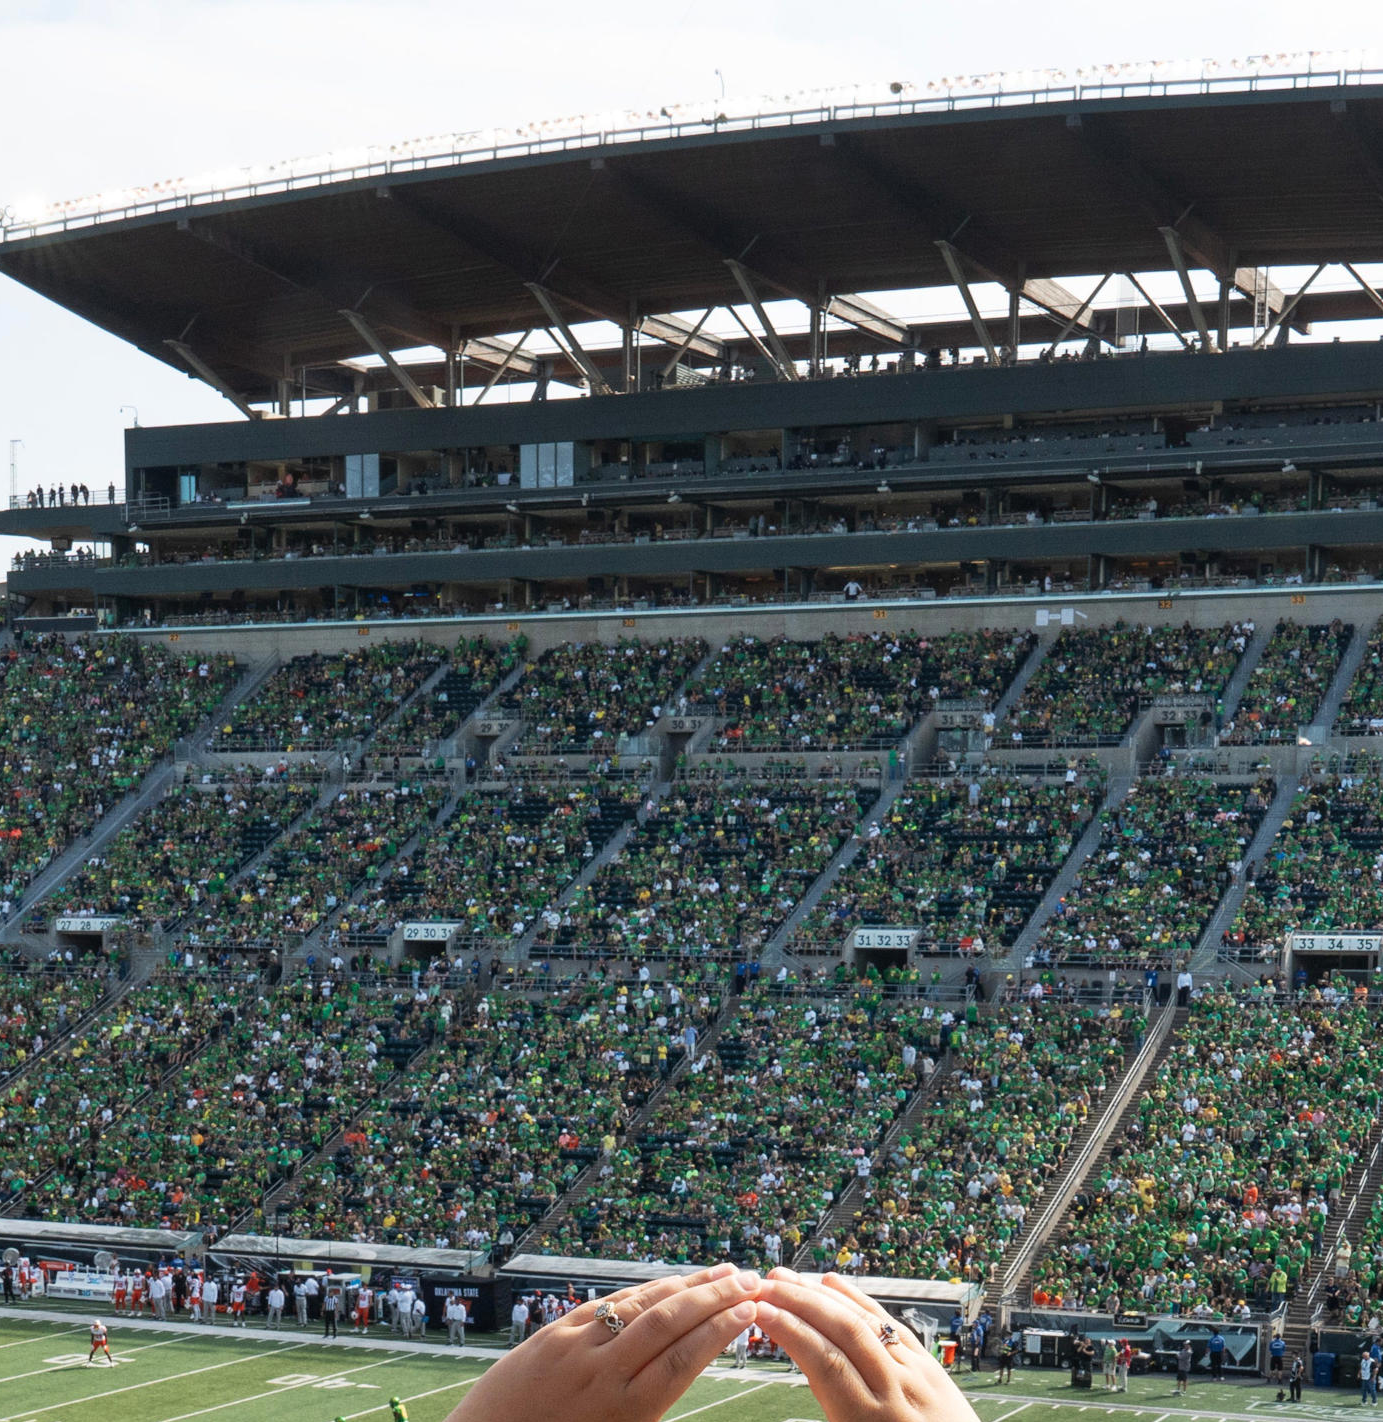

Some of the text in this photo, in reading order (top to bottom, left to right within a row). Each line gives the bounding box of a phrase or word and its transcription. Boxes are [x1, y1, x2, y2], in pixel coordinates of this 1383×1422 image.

[942, 715, 954, 725] 31
[1162, 710, 1176, 721] 32
[480, 723, 492, 733] 29
[672, 720, 684, 730] 30
[60, 920, 111, 930] 27 28 29
[406, 928, 419, 938] 29
[423, 928, 436, 938] 30
[858, 935, 910, 946] 31 32 33
[1299, 938, 1373, 949] 33 34 35
[434, 1287, 479, 1297] OKLAMA STATE
